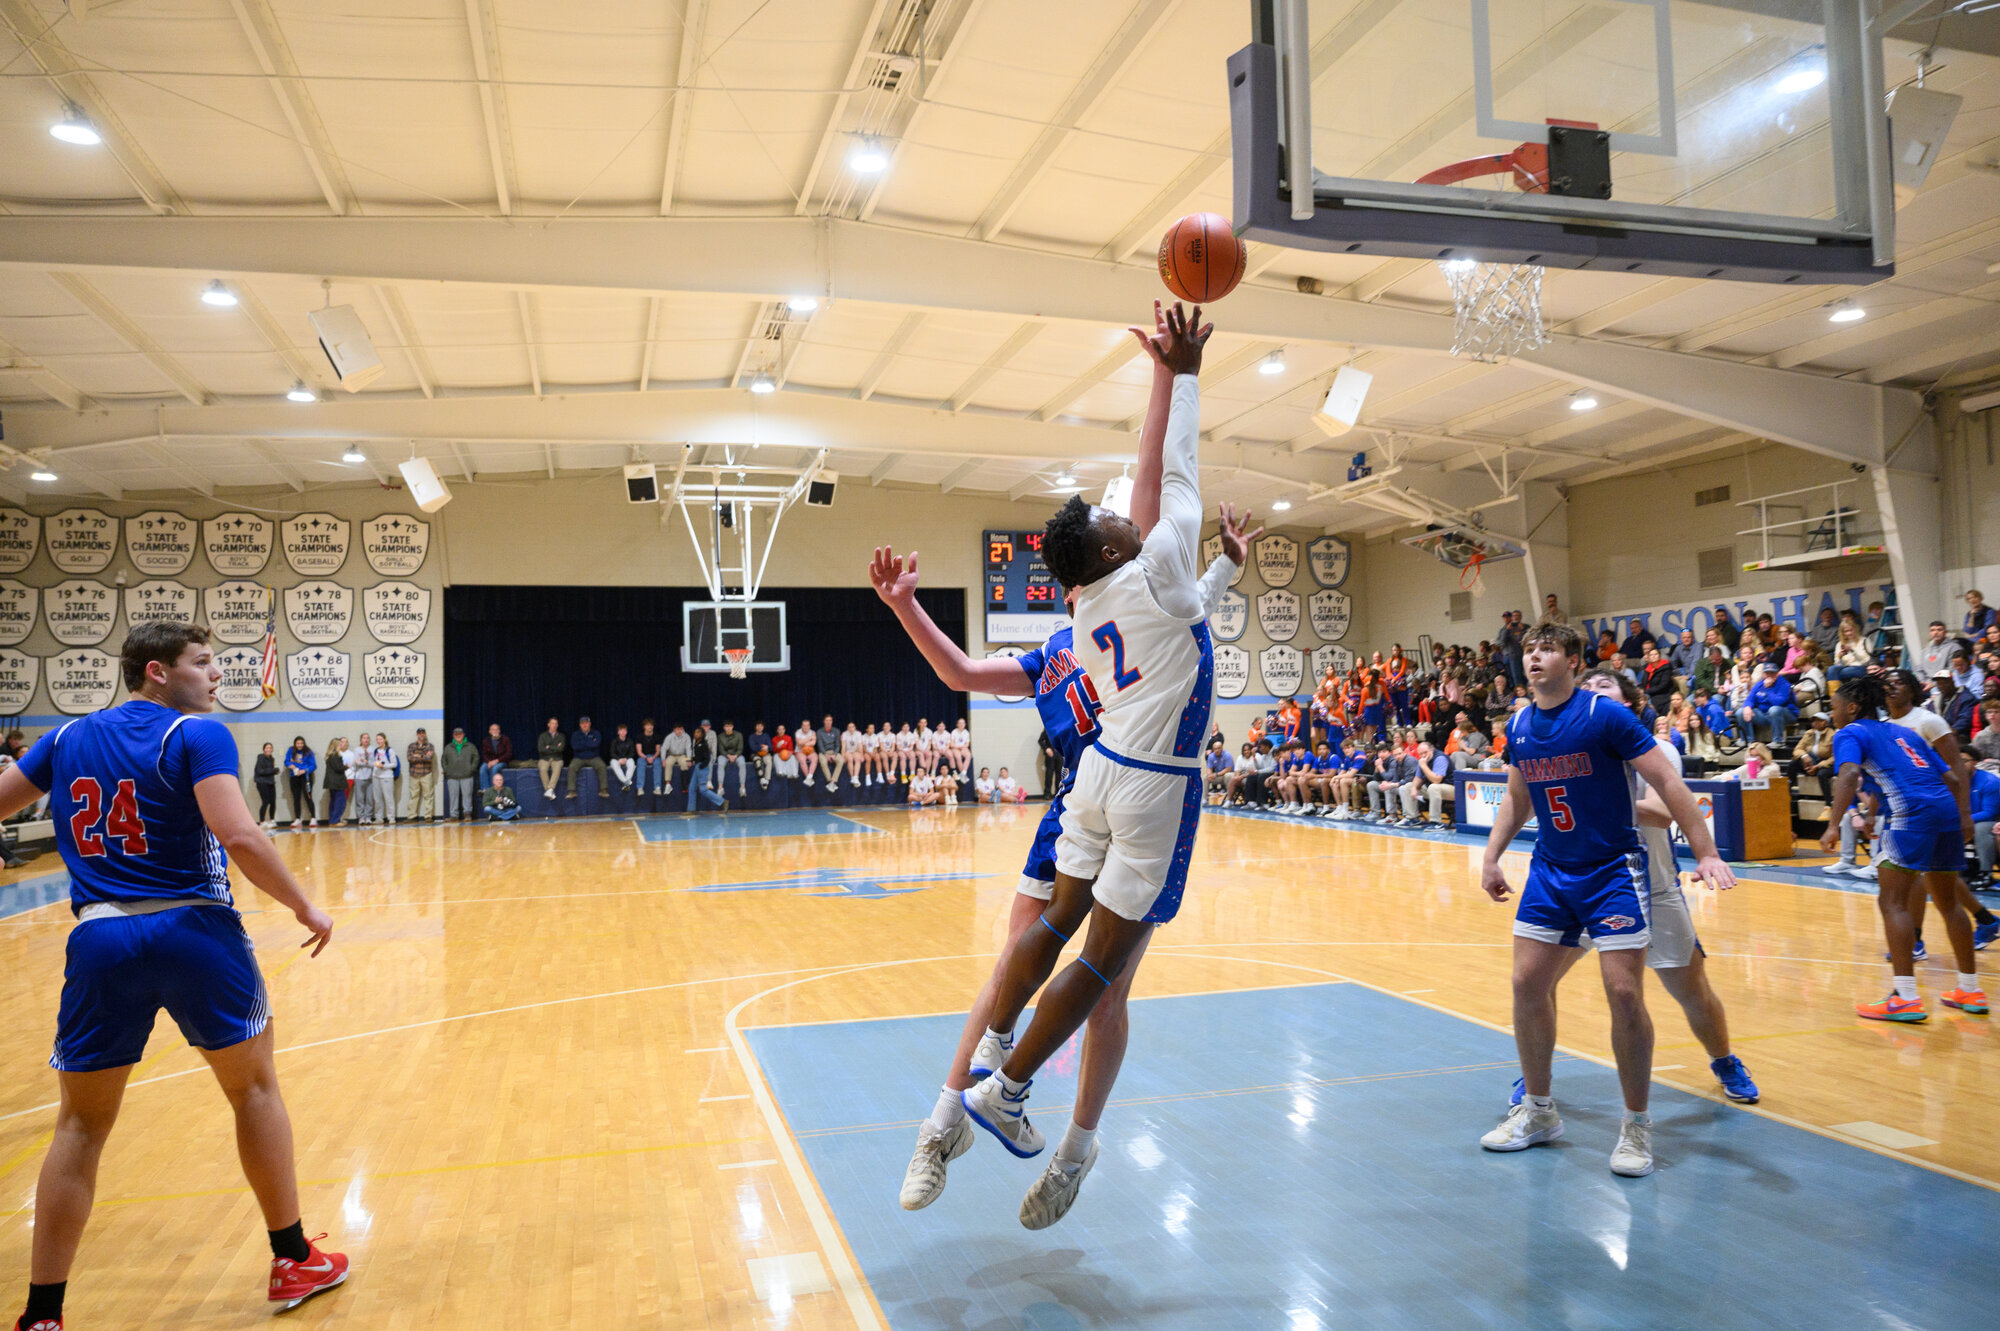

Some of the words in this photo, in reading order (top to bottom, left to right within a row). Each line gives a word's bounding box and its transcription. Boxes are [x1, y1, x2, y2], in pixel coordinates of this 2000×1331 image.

[13, 518, 28, 528] 70
[58, 518, 73, 528] 19
[91, 518, 107, 528] 70
[138, 520, 153, 530] 19
[172, 522, 186, 530] 70
[216, 522, 230, 530] 19
[248, 522, 262, 532] 70
[294, 522, 308, 532] 19
[325, 523, 338, 532] 74
[374, 523, 388, 532] 19
[405, 524, 418, 532] 75
[0, 530, 19, 540] ATE
[66, 531, 98, 540] STATE
[146, 533, 178, 542] STATE
[224, 534, 254, 543] STATE
[301, 534, 331, 544] STATE
[381, 536, 410, 544] STATE
[0, 540, 32, 550] PIONS
[51, 540, 111, 550] CHAMPIONS
[131, 542, 190, 552] CHAMPIONS
[210, 544, 266, 553] CHAMPIONS
[288, 544, 344, 553] CHAMPIONS
[368, 545, 422, 554] CHAMPIONS
[1209, 542, 1218, 550] 19
[990, 542, 1013, 562] 27
[1264, 552, 1290, 560] STATE
[1312, 552, 1346, 560] PRESIDENT'S
[146, 557, 178, 565] SOCCER
[1324, 561, 1334, 570] CUP
[1030, 562, 1048, 572] perio
[1030, 574, 1050, 582] player
[11, 590, 26, 598] 75
[58, 590, 72, 599] 19
[92, 590, 106, 600] 76
[138, 590, 152, 599] 19
[171, 590, 185, 600] 76
[218, 590, 231, 598] 19
[250, 590, 263, 599] 77
[297, 590, 310, 600] 19
[328, 590, 342, 600] 78
[376, 590, 388, 600] 19
[406, 592, 418, 600] 80
[994, 586, 1004, 600] 2
[0, 602, 16, 611] ATE
[65, 602, 98, 612] STATE
[145, 602, 176, 612] STATE
[224, 602, 255, 610] STATE
[304, 602, 334, 612] STATE
[382, 602, 412, 612] STATE
[1216, 604, 1245, 613] ESIDENT'S
[0, 612, 31, 621] PIONS
[50, 612, 110, 621] CHAMPIONS
[130, 612, 190, 621] CHAMPIONS
[211, 611, 268, 620] CHAMPIONS
[291, 612, 346, 621] CHAMPIONS
[370, 612, 423, 621] CHAMPIONS
[1222, 614, 1233, 622] CUP
[992, 624, 1020, 632] Home
[1022, 624, 1034, 632] of
[1036, 623, 1050, 633] the
[296, 656, 308, 665] 19
[328, 656, 342, 664] 88
[374, 656, 386, 664] 19
[404, 655, 418, 664] 89
[1091, 620, 1142, 692] 2
[10, 658, 24, 668] 81
[60, 658, 74, 668] 19
[92, 658, 108, 668] 83
[218, 656, 232, 666] 19
[249, 656, 264, 666] 87
[1216, 662, 1240, 670] STATE
[1321, 662, 1345, 670] STTE
[0, 671, 17, 680] ATE
[66, 670, 98, 680] STATE
[224, 668, 257, 678] STATE
[300, 668, 335, 676] STATE
[376, 666, 410, 676] STATE
[1040, 648, 1080, 694] HAMM
[52, 680, 112, 690] CHAMPIONS
[220, 678, 262, 687] HAMPION
[292, 676, 344, 686] CHAMPIONS
[368, 676, 420, 685] CHAMPIONS
[0, 682, 30, 690] PIONS
[1518, 752, 1593, 784] HAMMOND
[1544, 786, 1576, 832] 5
[70, 776, 148, 858] 24
